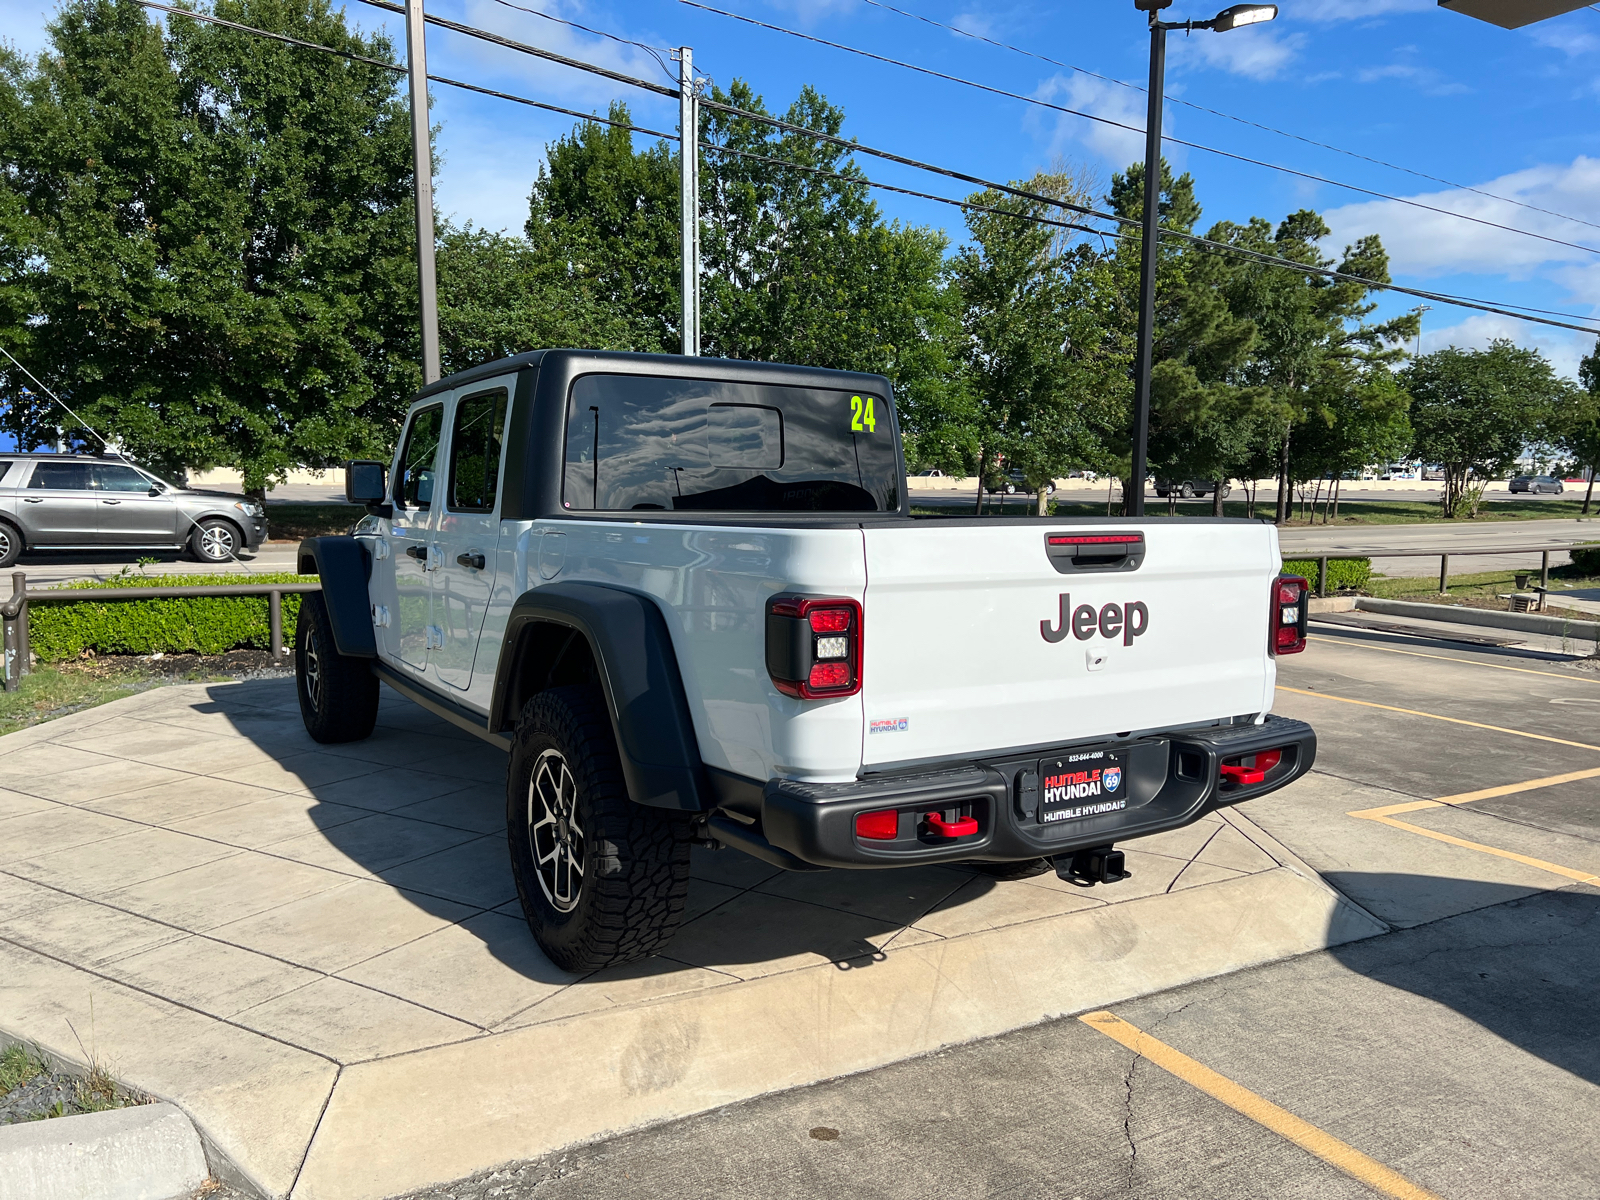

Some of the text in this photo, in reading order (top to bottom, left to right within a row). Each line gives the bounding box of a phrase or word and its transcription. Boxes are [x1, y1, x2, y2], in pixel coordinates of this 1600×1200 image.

[850, 395, 876, 433] 24
[1039, 592, 1149, 647] Jeep
[1045, 769, 1101, 788] HUMBLE
[1105, 776, 1118, 788] 69
[1044, 781, 1101, 803] HYUNDAI
[1044, 808, 1081, 822] HUMBLE
[1082, 801, 1120, 815] HYUNDAI
